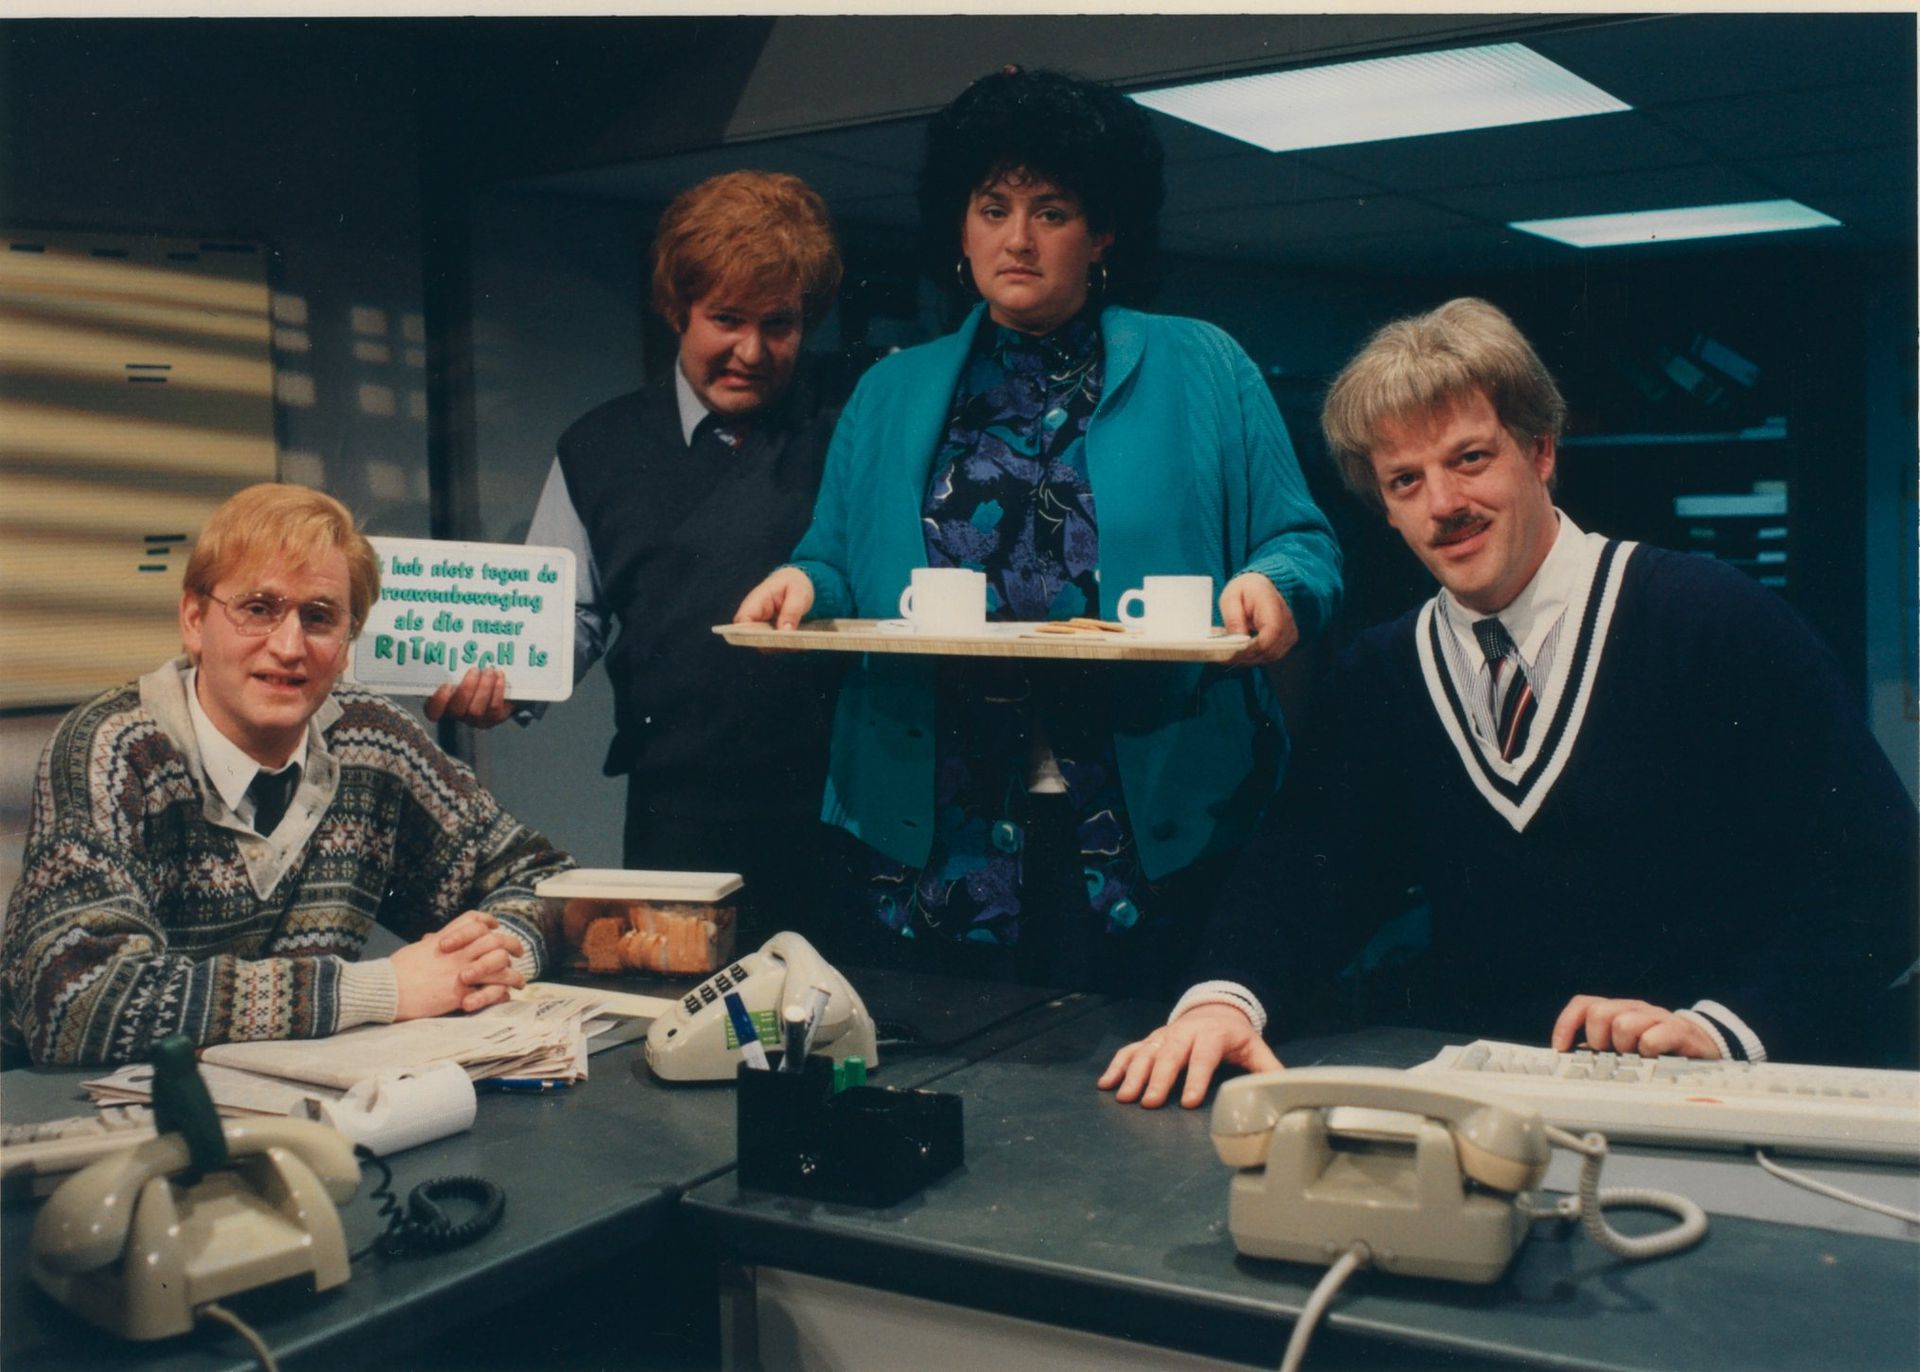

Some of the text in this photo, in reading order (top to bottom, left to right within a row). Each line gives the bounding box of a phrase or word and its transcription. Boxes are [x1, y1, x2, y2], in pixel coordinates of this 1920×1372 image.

[392, 556, 424, 577] heb
[430, 560, 474, 579] niets
[481, 563, 530, 586] tegen
[536, 563, 558, 584] de
[381, 585, 544, 614] rouwenbeweging
[394, 609, 524, 636] als die maar
[528, 644, 549, 668] is
